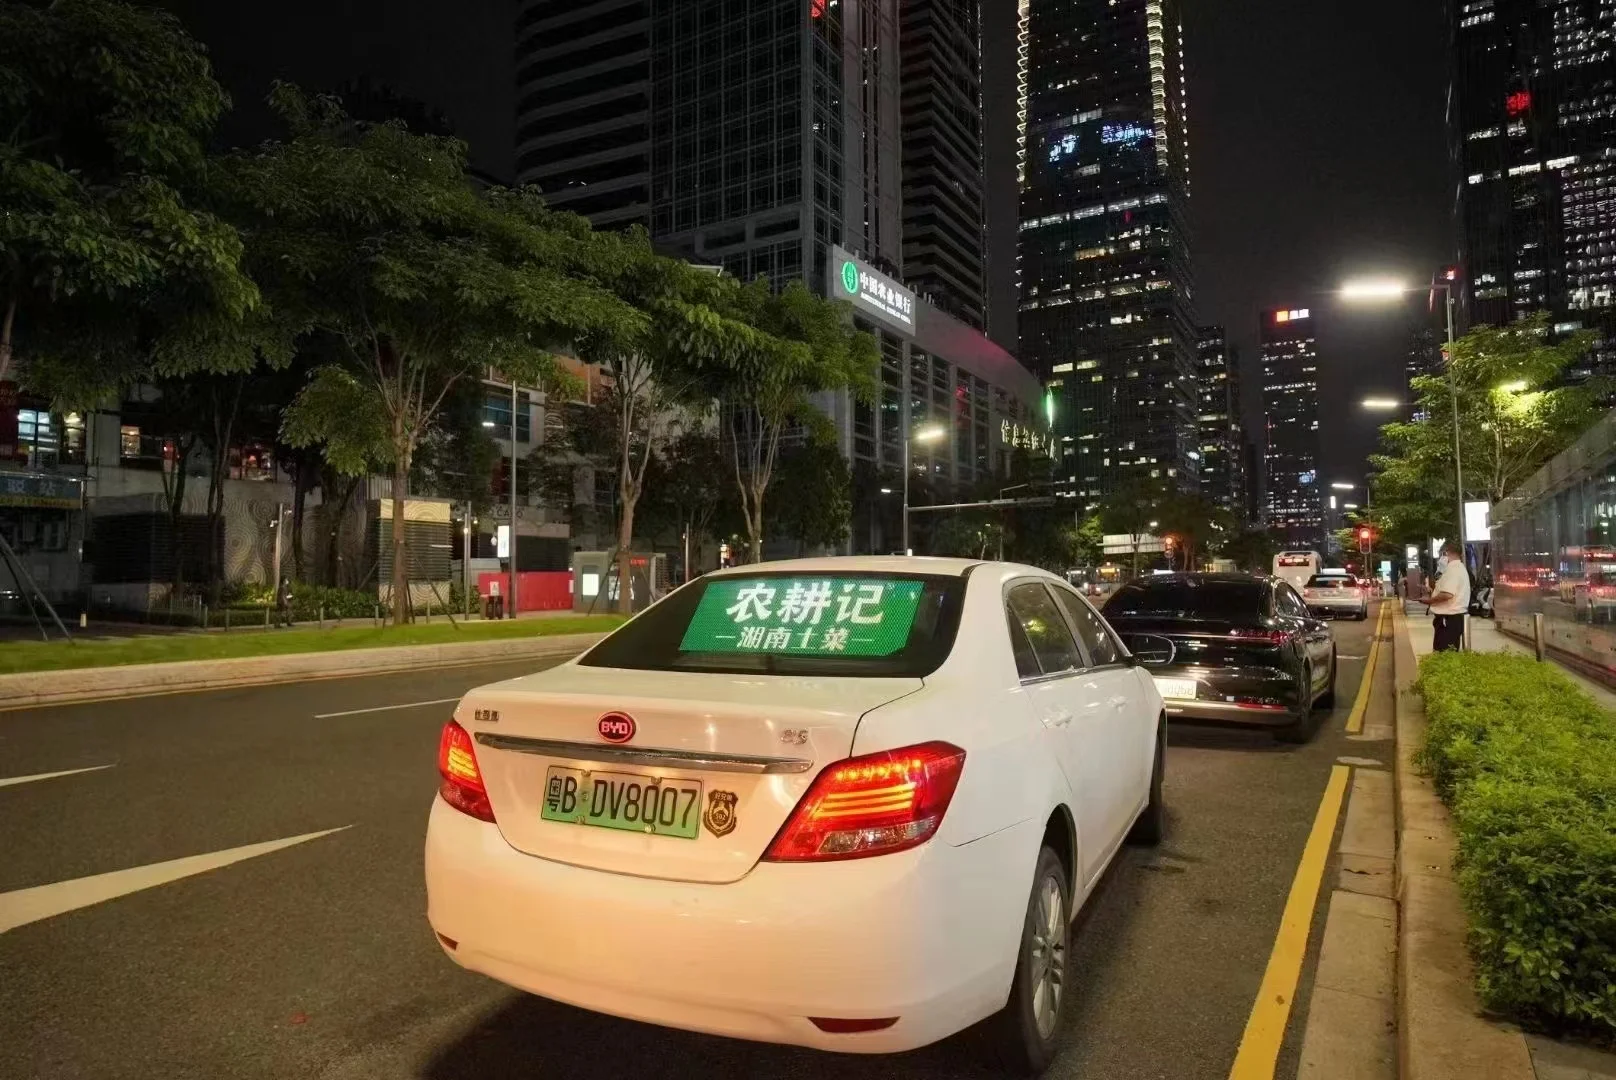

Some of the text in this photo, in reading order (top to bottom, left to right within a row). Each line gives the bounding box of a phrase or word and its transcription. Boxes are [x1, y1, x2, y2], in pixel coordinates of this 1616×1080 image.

[859, 271, 911, 314] 中国农业银行
[725, 581, 885, 625] 农耕记
[601, 721, 628, 734] BYD
[589, 779, 698, 829] DV8007
